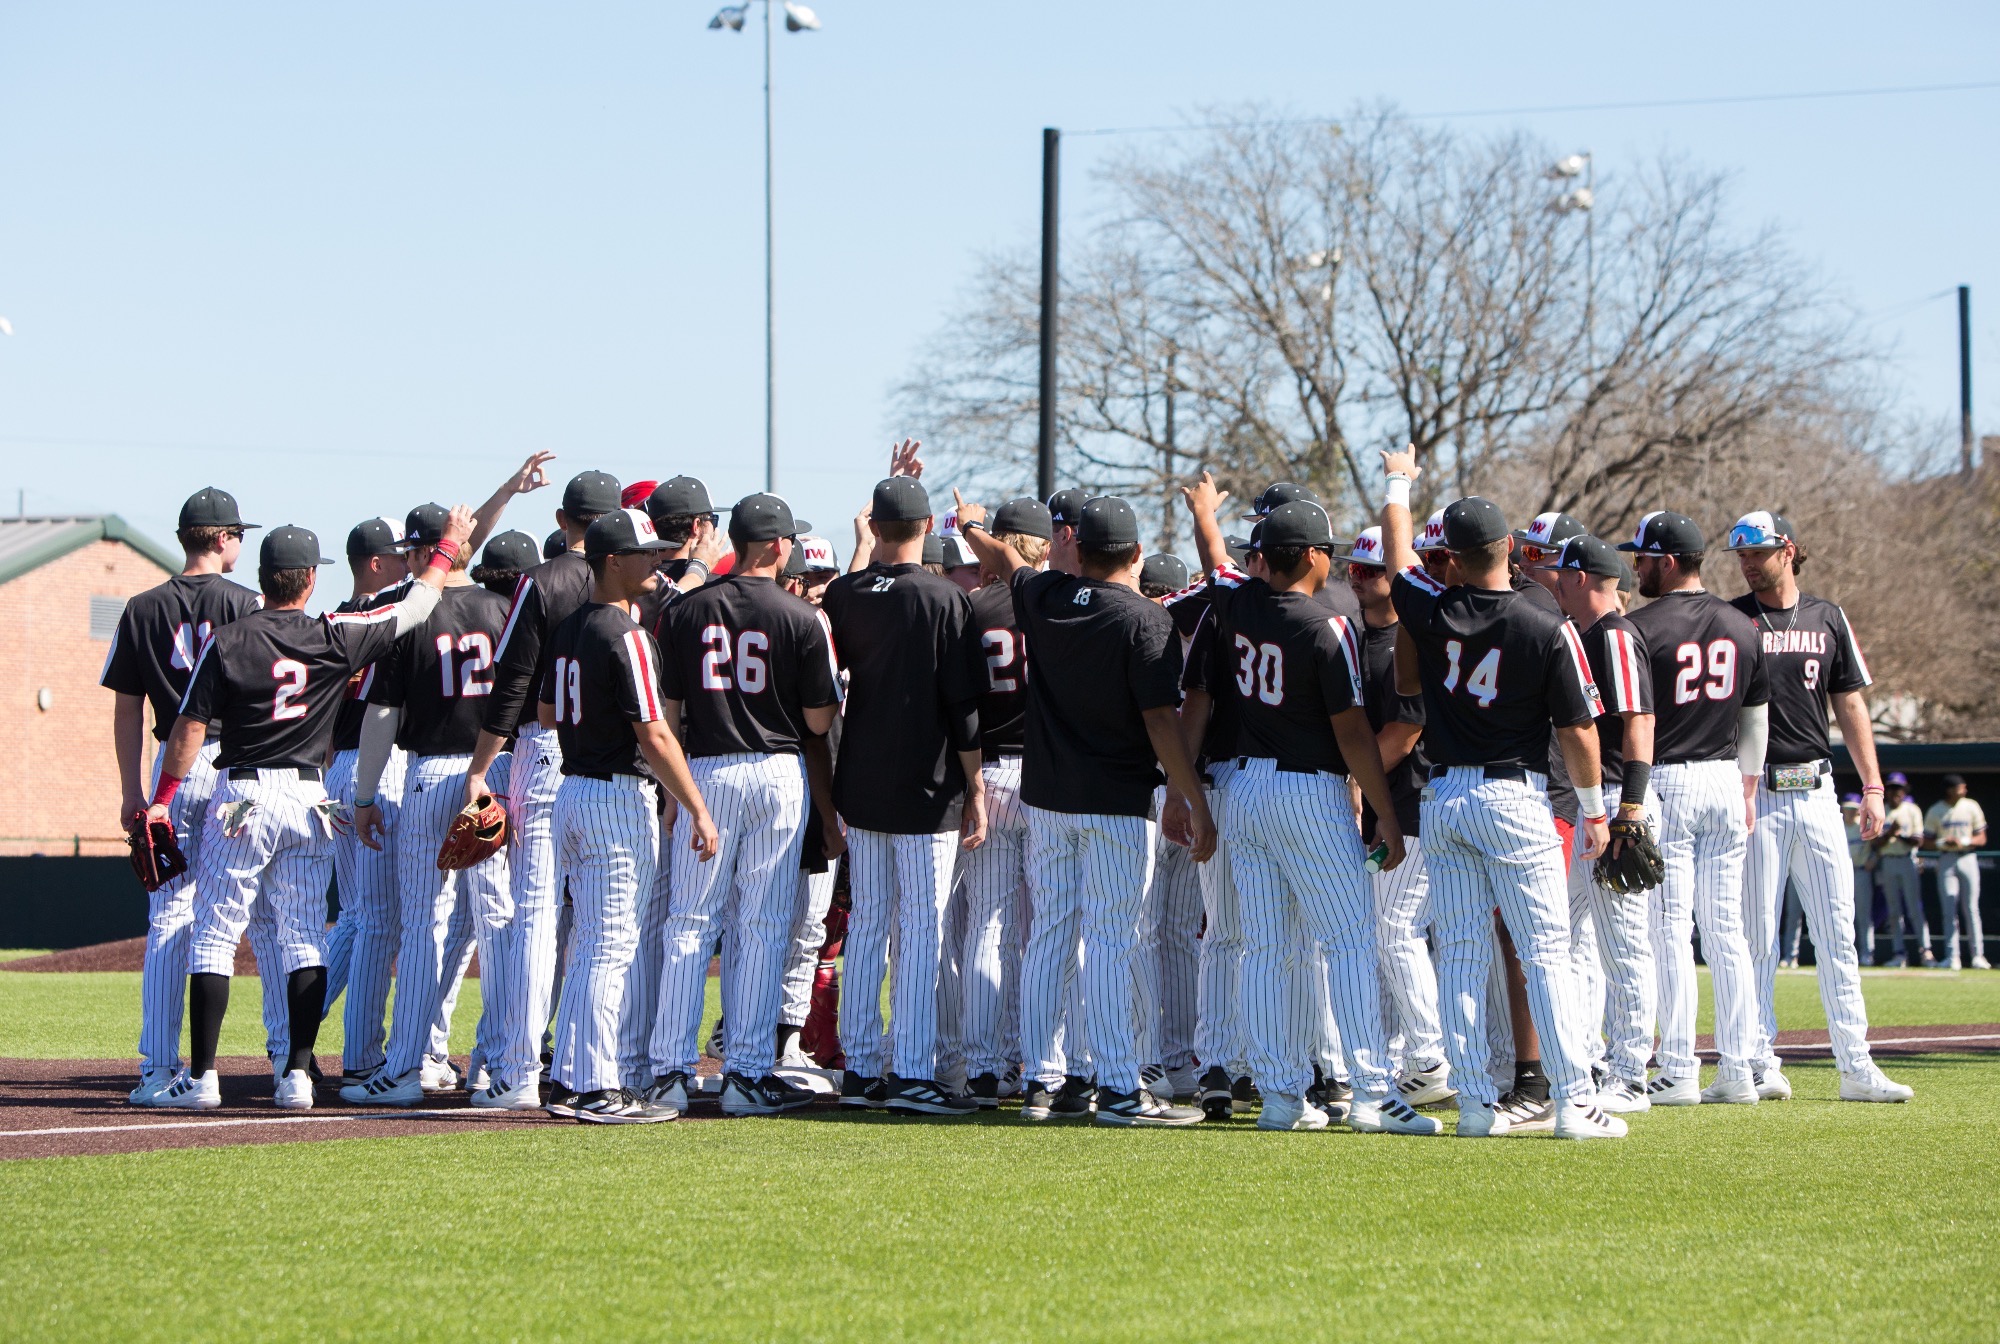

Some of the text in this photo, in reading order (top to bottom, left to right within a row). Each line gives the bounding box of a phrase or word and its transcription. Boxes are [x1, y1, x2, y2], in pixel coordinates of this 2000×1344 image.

[871, 575, 896, 592] 27
[1072, 586, 1092, 606] 18
[272, 657, 308, 720] 2
[435, 631, 494, 698] 12
[555, 656, 582, 726] 19
[701, 624, 769, 694] 26
[980, 626, 1029, 694] 2
[1234, 631, 1284, 707] 30
[1443, 639, 1502, 708] 14
[1674, 637, 1737, 705] 29
[1804, 658, 1820, 690] 9
